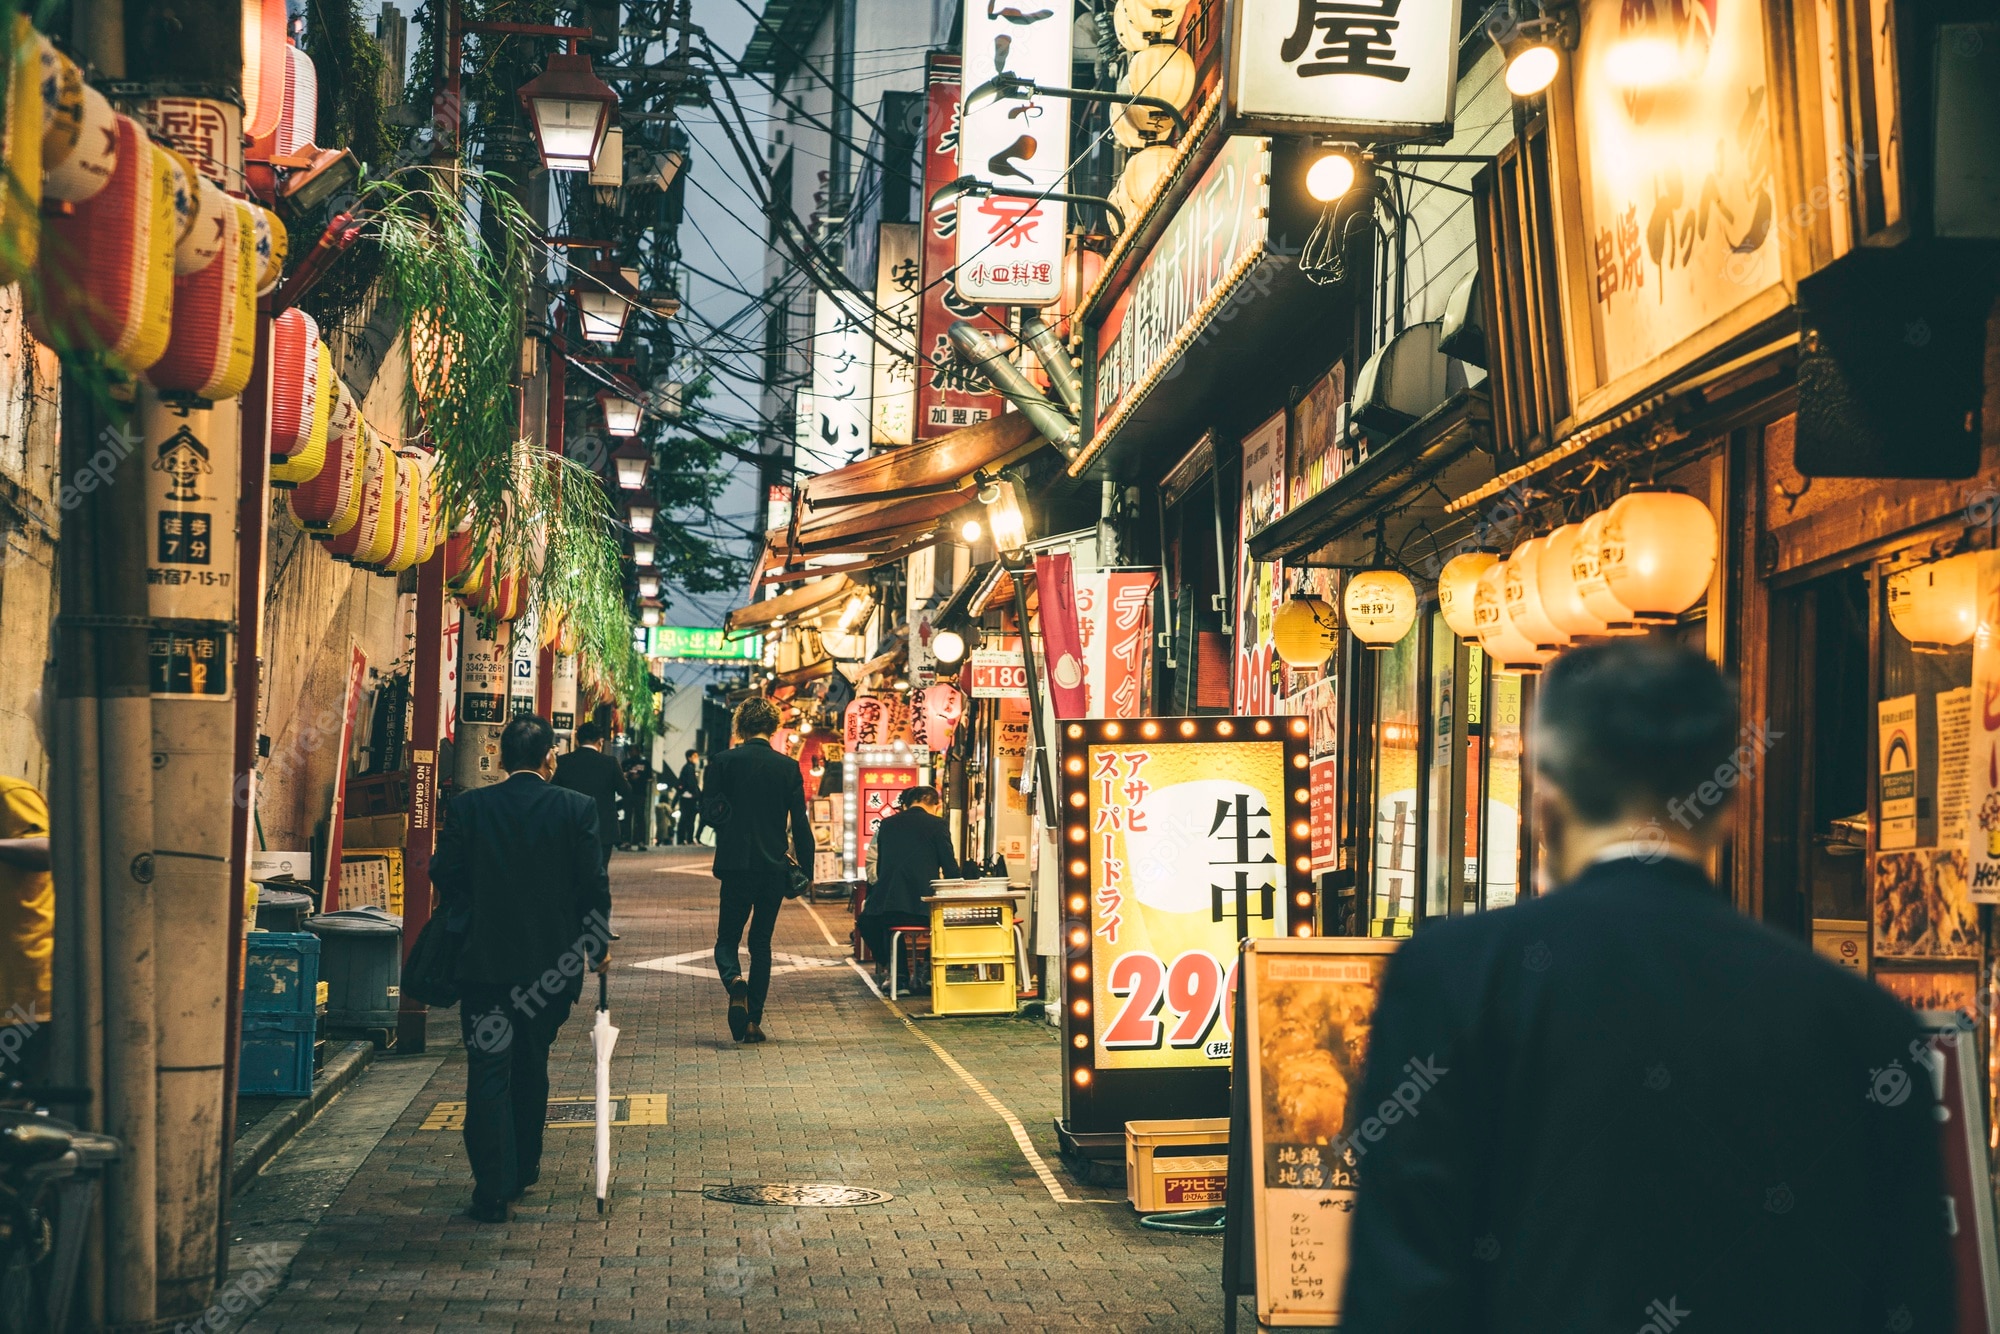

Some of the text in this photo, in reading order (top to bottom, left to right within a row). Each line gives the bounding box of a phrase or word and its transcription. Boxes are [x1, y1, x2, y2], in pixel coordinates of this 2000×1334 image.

[1281, 0, 1410, 82] 屋
[971, 263, 1051, 284] 小皿料理
[931, 408, 989, 424] 加盟店
[164, 518, 208, 536] 徒歩
[1352, 604, 1395, 615] 一番搾り
[470, 700, 497, 709] 西新宿
[473, 711, 493, 719] 1-2
[414, 765, 425, 828] NO GRAFFITI
[1123, 752, 1150, 832] アサヒ
[1095, 752, 1123, 942] スーパードライ
[1207, 794, 1278, 942] 生中
[1102, 952, 1238, 1050] 29
[1277, 1147, 1321, 1166] 地鶏
[1278, 1168, 1323, 1188] 地鶏
